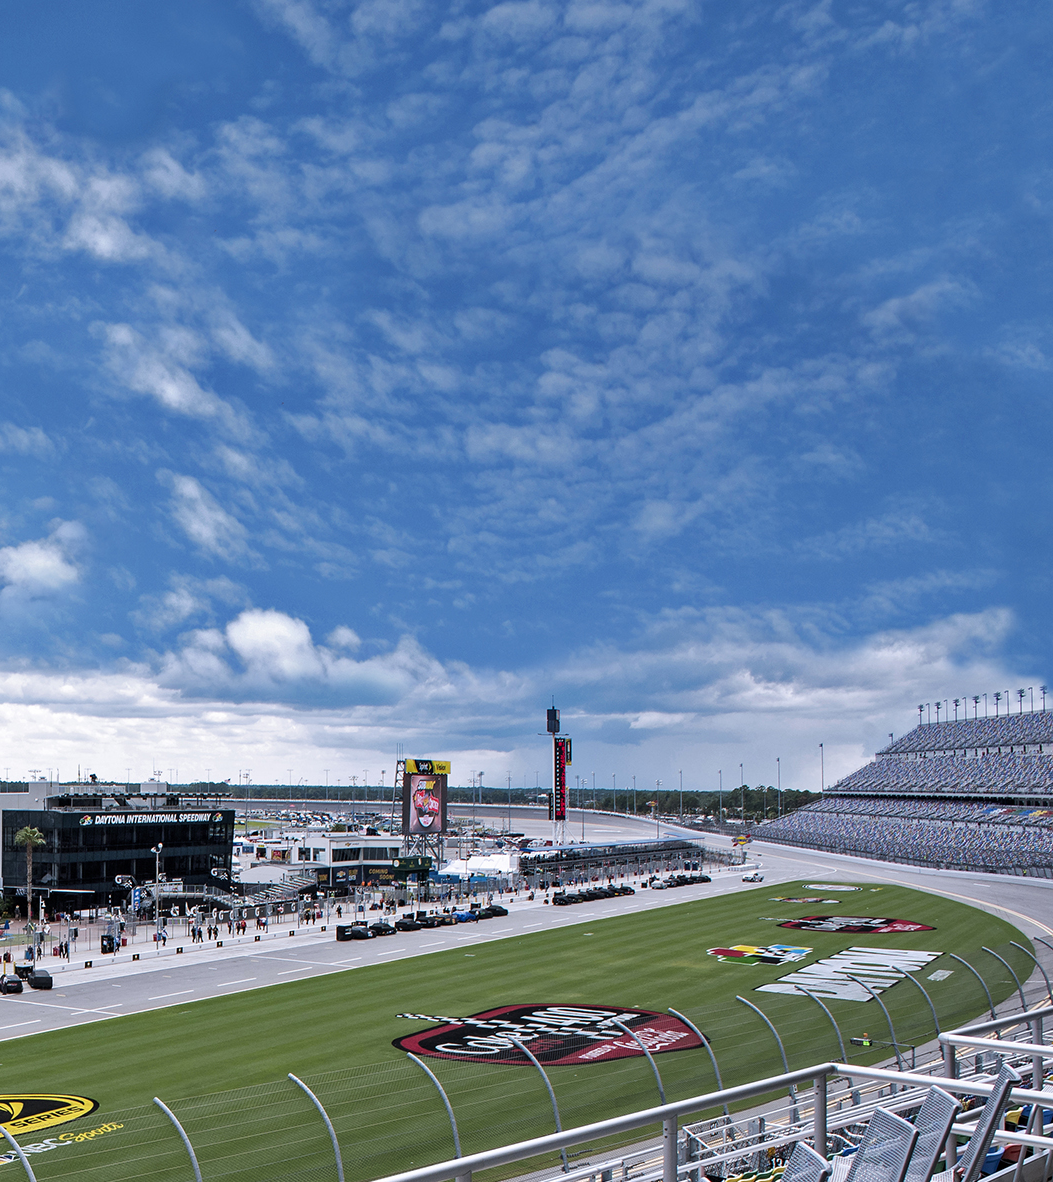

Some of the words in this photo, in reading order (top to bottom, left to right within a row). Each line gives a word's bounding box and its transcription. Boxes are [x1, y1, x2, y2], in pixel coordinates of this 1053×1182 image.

[94, 814, 126, 825] DAYTONA
[126, 813, 178, 824] INTERNATIONAL
[178, 812, 212, 823] SPEEDWAY
[520, 1006, 618, 1027] 400
[435, 1030, 540, 1056] Coke
[14, 1105, 86, 1128] SERIES
[58, 1121, 125, 1144] Sports
